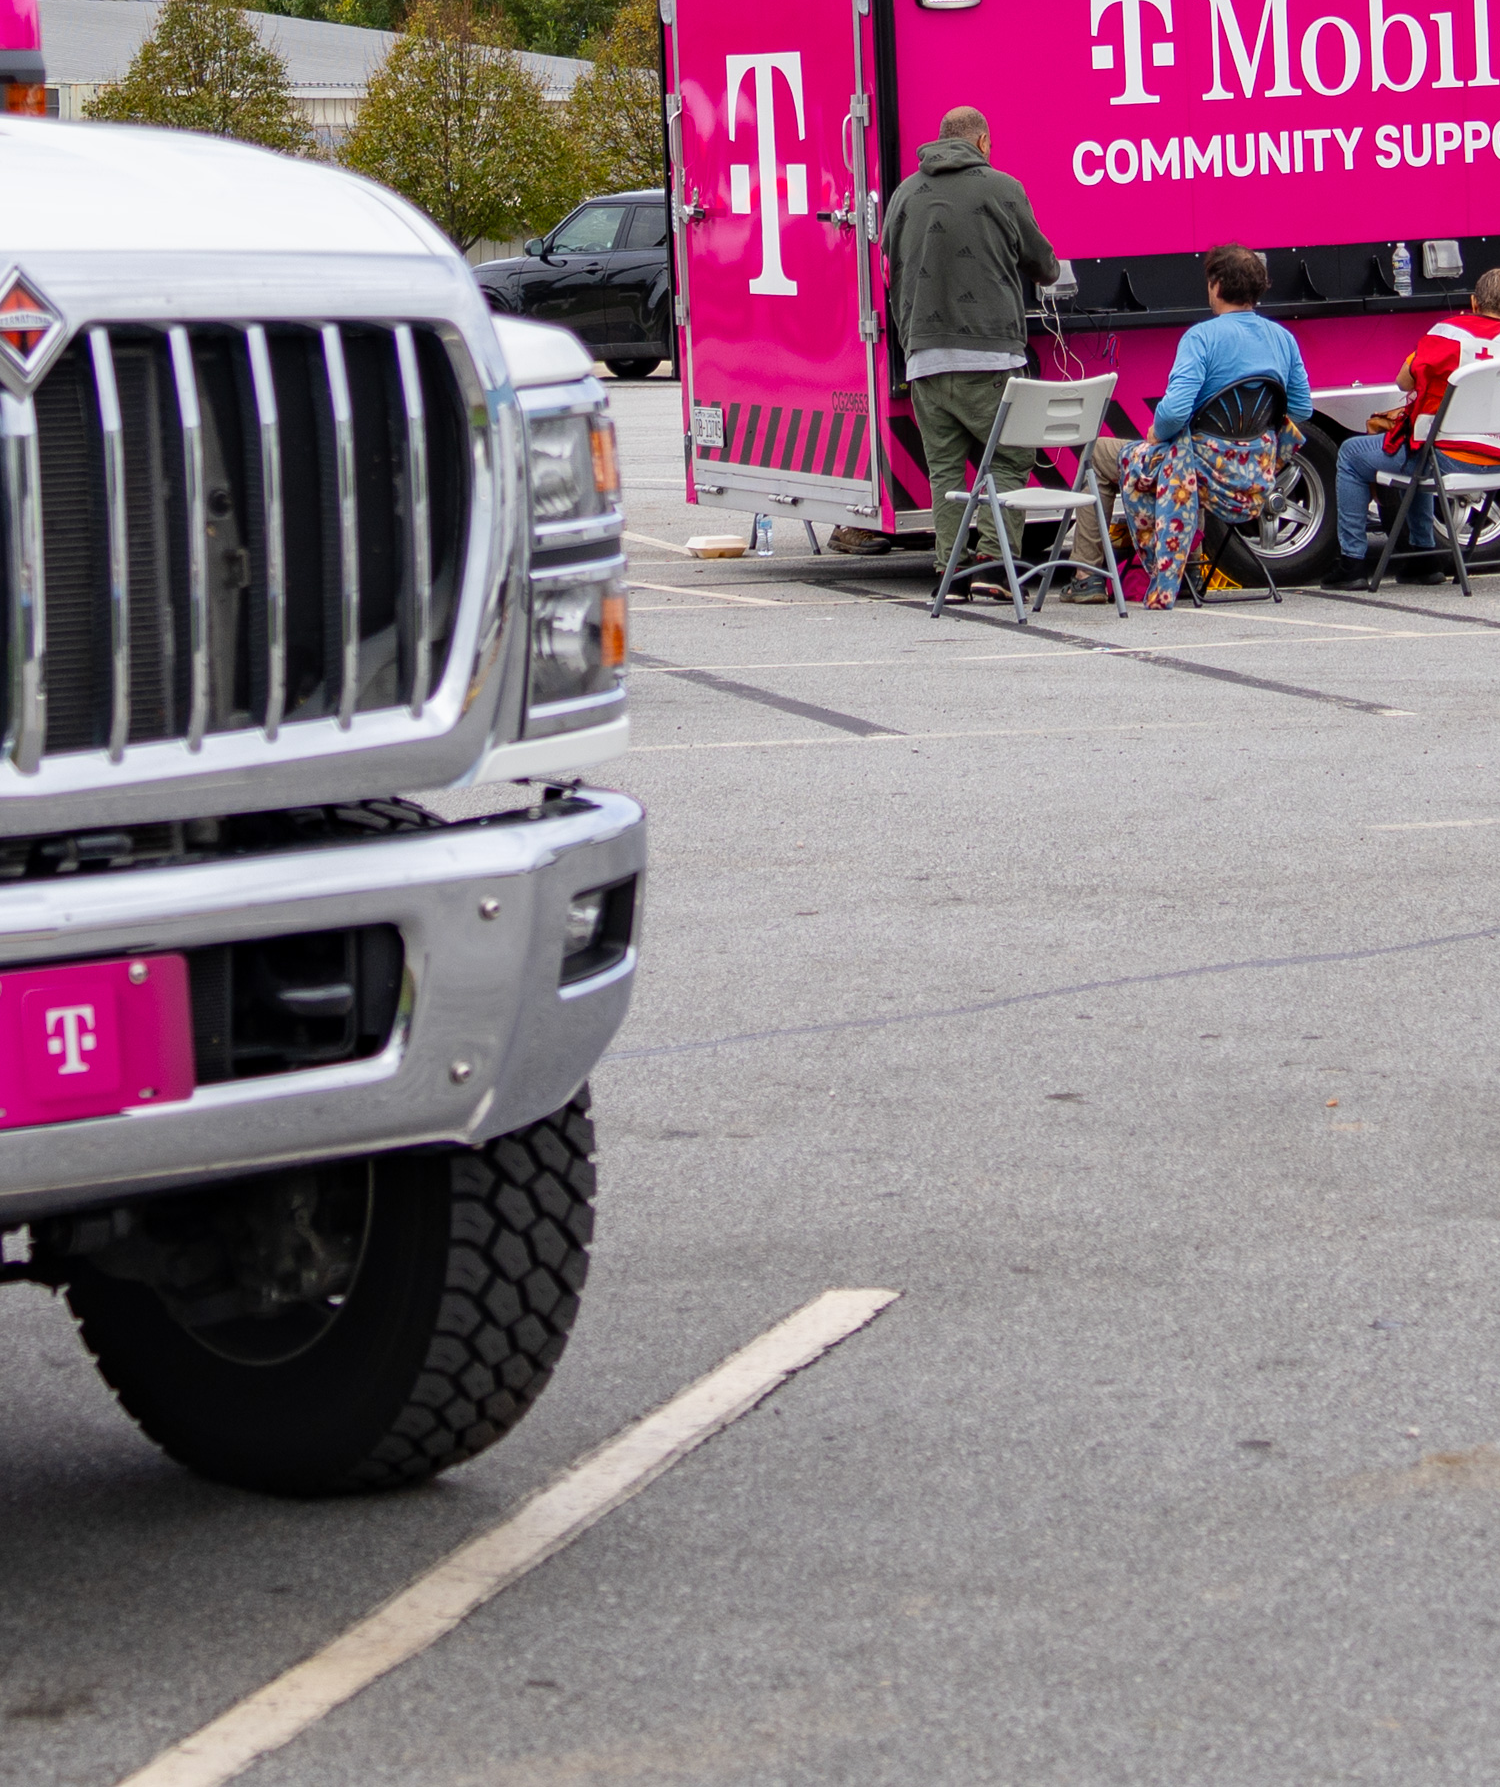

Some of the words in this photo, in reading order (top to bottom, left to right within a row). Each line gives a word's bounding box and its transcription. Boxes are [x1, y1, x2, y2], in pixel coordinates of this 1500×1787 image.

[725, 51, 808, 297] T
[1072, 126, 1363, 186] COMMUNITY
[44, 1003, 97, 1076] T
